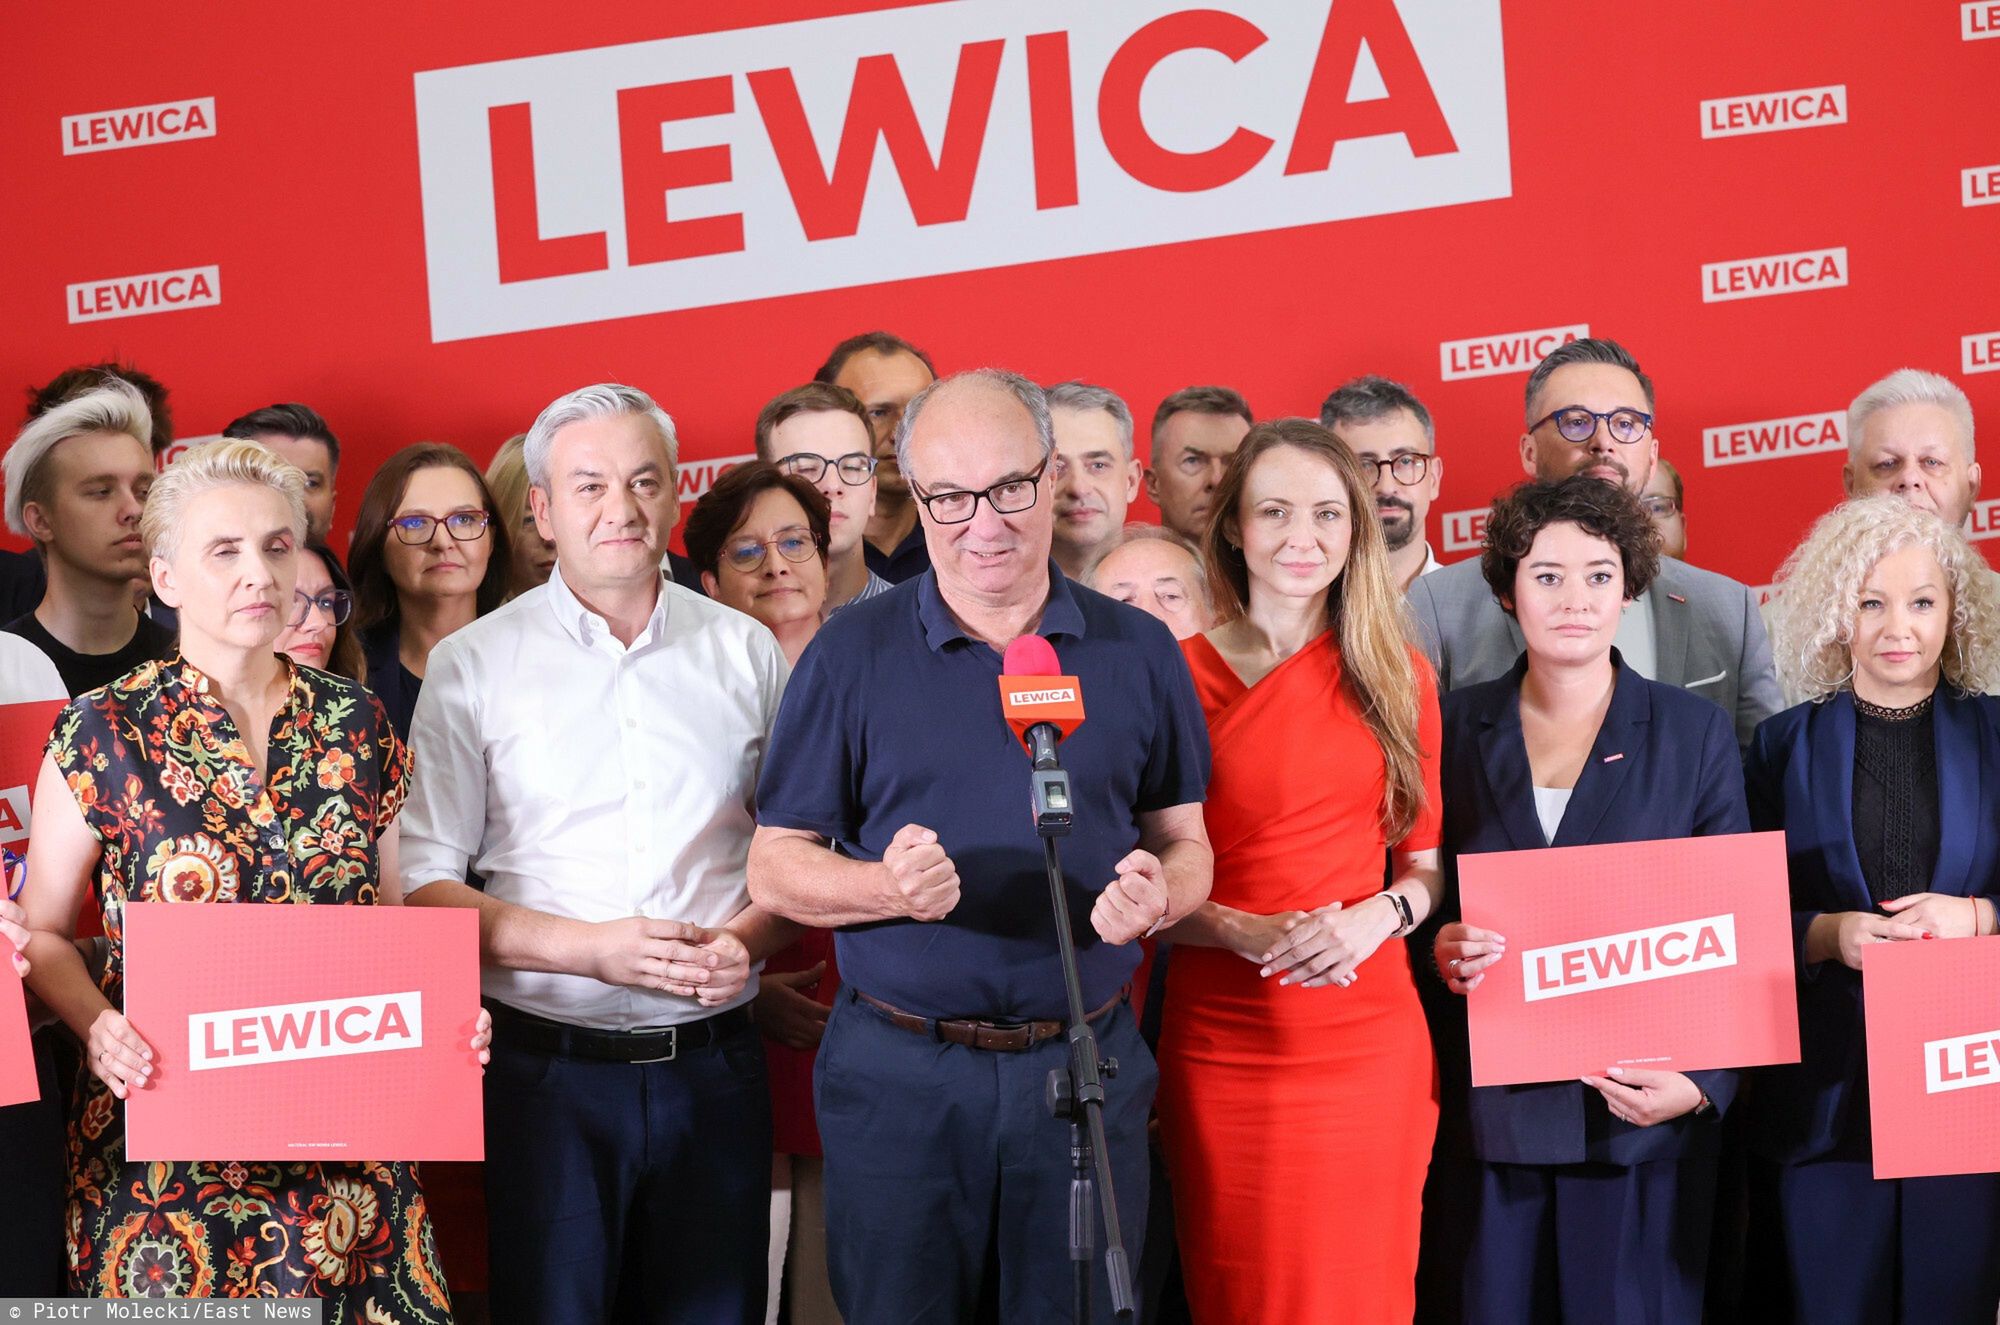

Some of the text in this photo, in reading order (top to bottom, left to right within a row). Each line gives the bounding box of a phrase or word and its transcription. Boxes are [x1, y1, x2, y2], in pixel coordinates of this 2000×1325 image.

[72, 106, 208, 148] LEWICA
[1711, 93, 1840, 131] LEWICA
[488, 0, 1458, 284] LEWICA
[77, 274, 212, 316] LEWICA
[1712, 256, 1841, 295] LEWICA
[1713, 419, 1841, 459] LEWICA
[1453, 514, 1488, 544] LE
[1014, 690, 1071, 703] LEWICA
[1537, 926, 1726, 991] LEWICA
[205, 1003, 412, 1060] LEWICA
